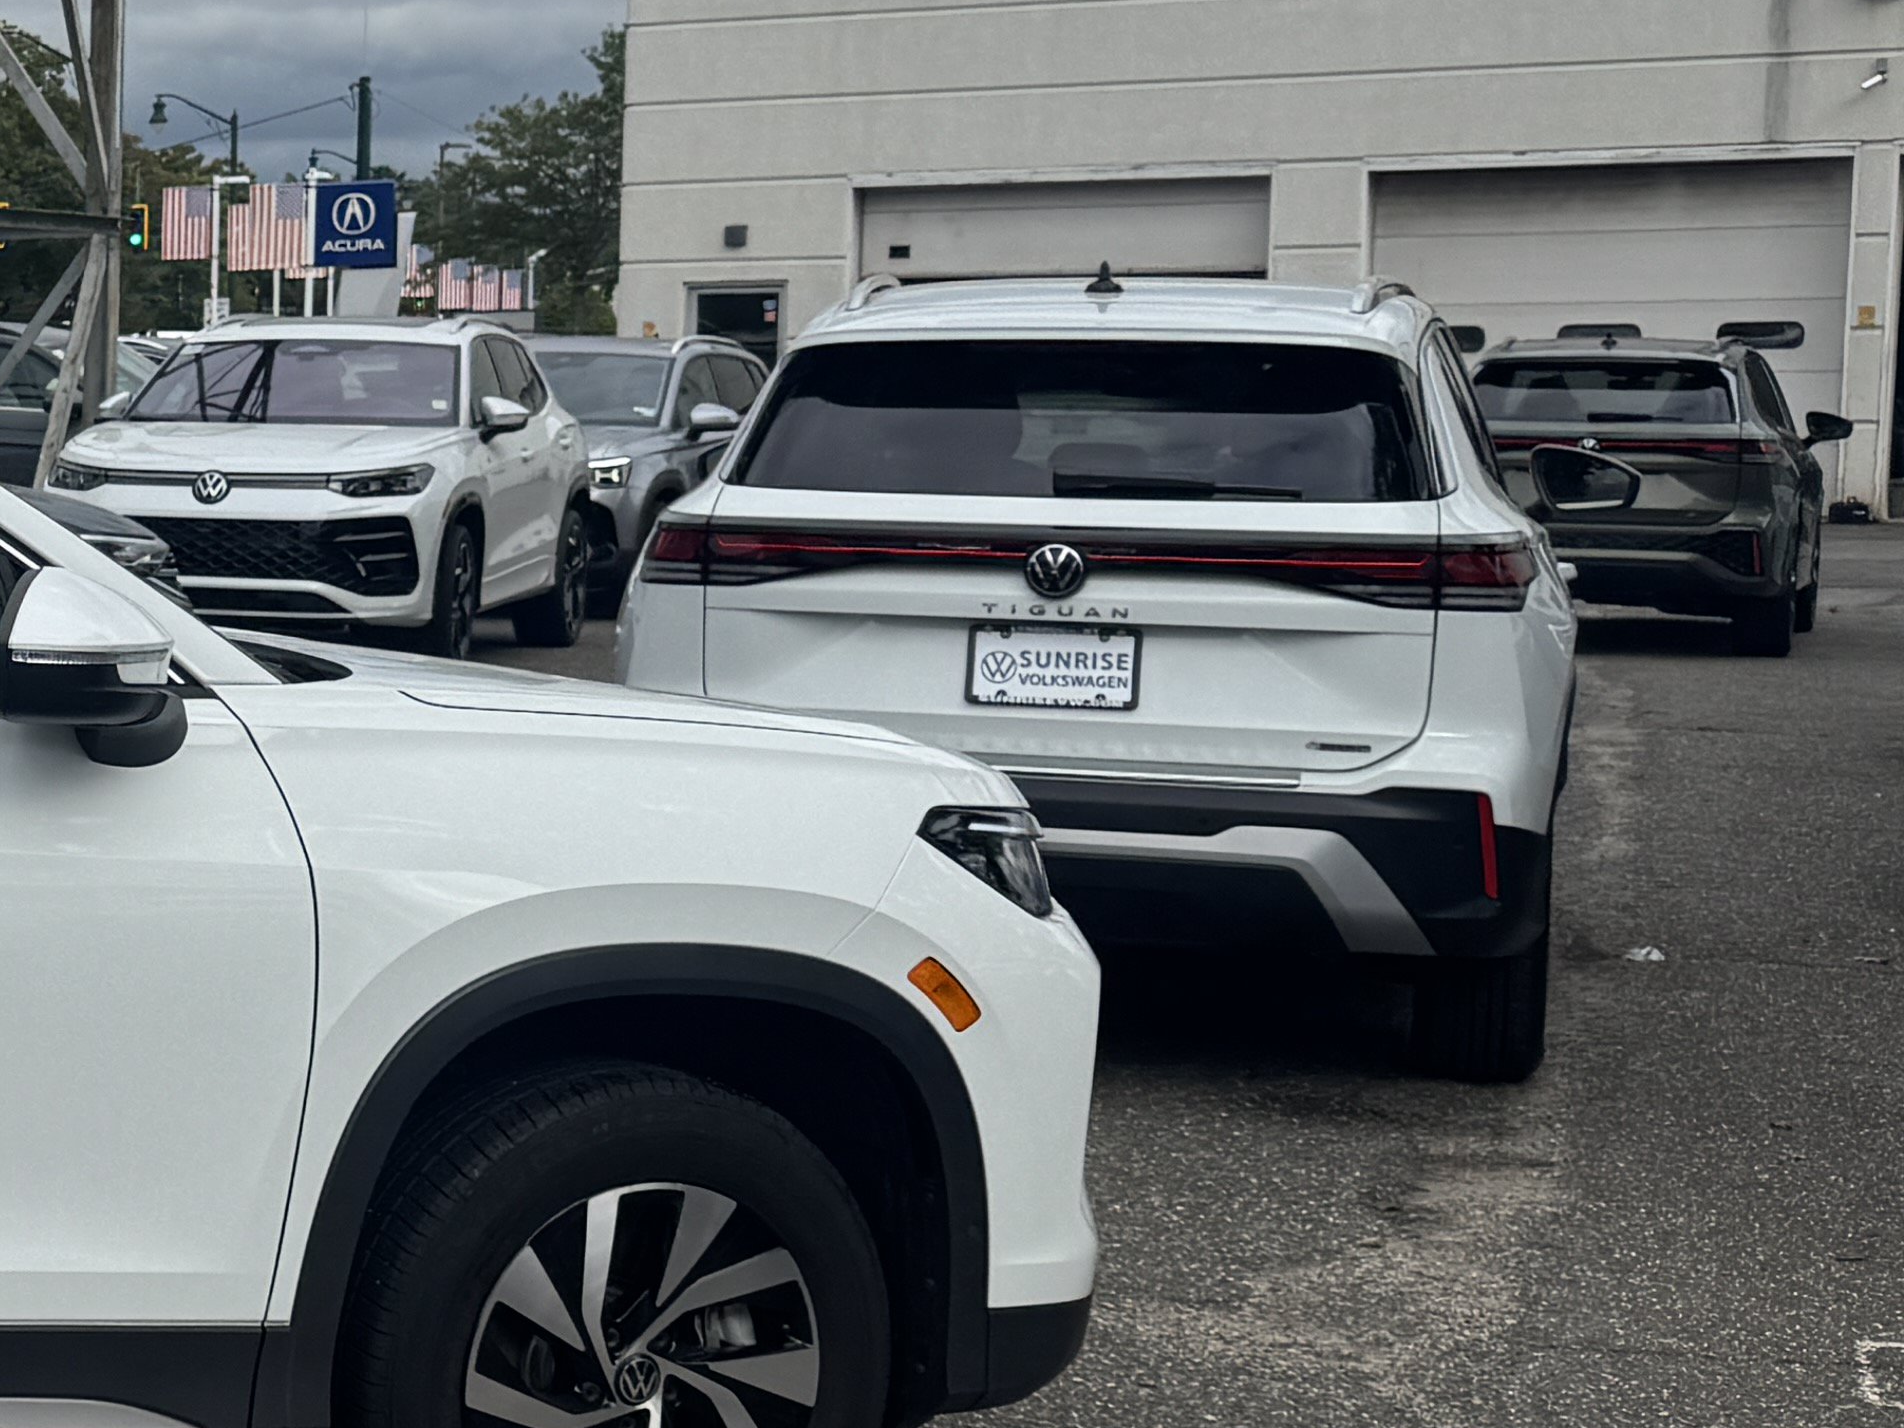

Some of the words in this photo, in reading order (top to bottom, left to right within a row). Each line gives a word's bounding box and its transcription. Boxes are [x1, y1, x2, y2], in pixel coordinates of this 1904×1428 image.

[321, 238, 385, 252] ACURA
[982, 602, 1129, 619] TIGUAN
[1020, 650, 1130, 671] SUNRISE
[1018, 673, 1129, 689] VOLKSWAGEN
